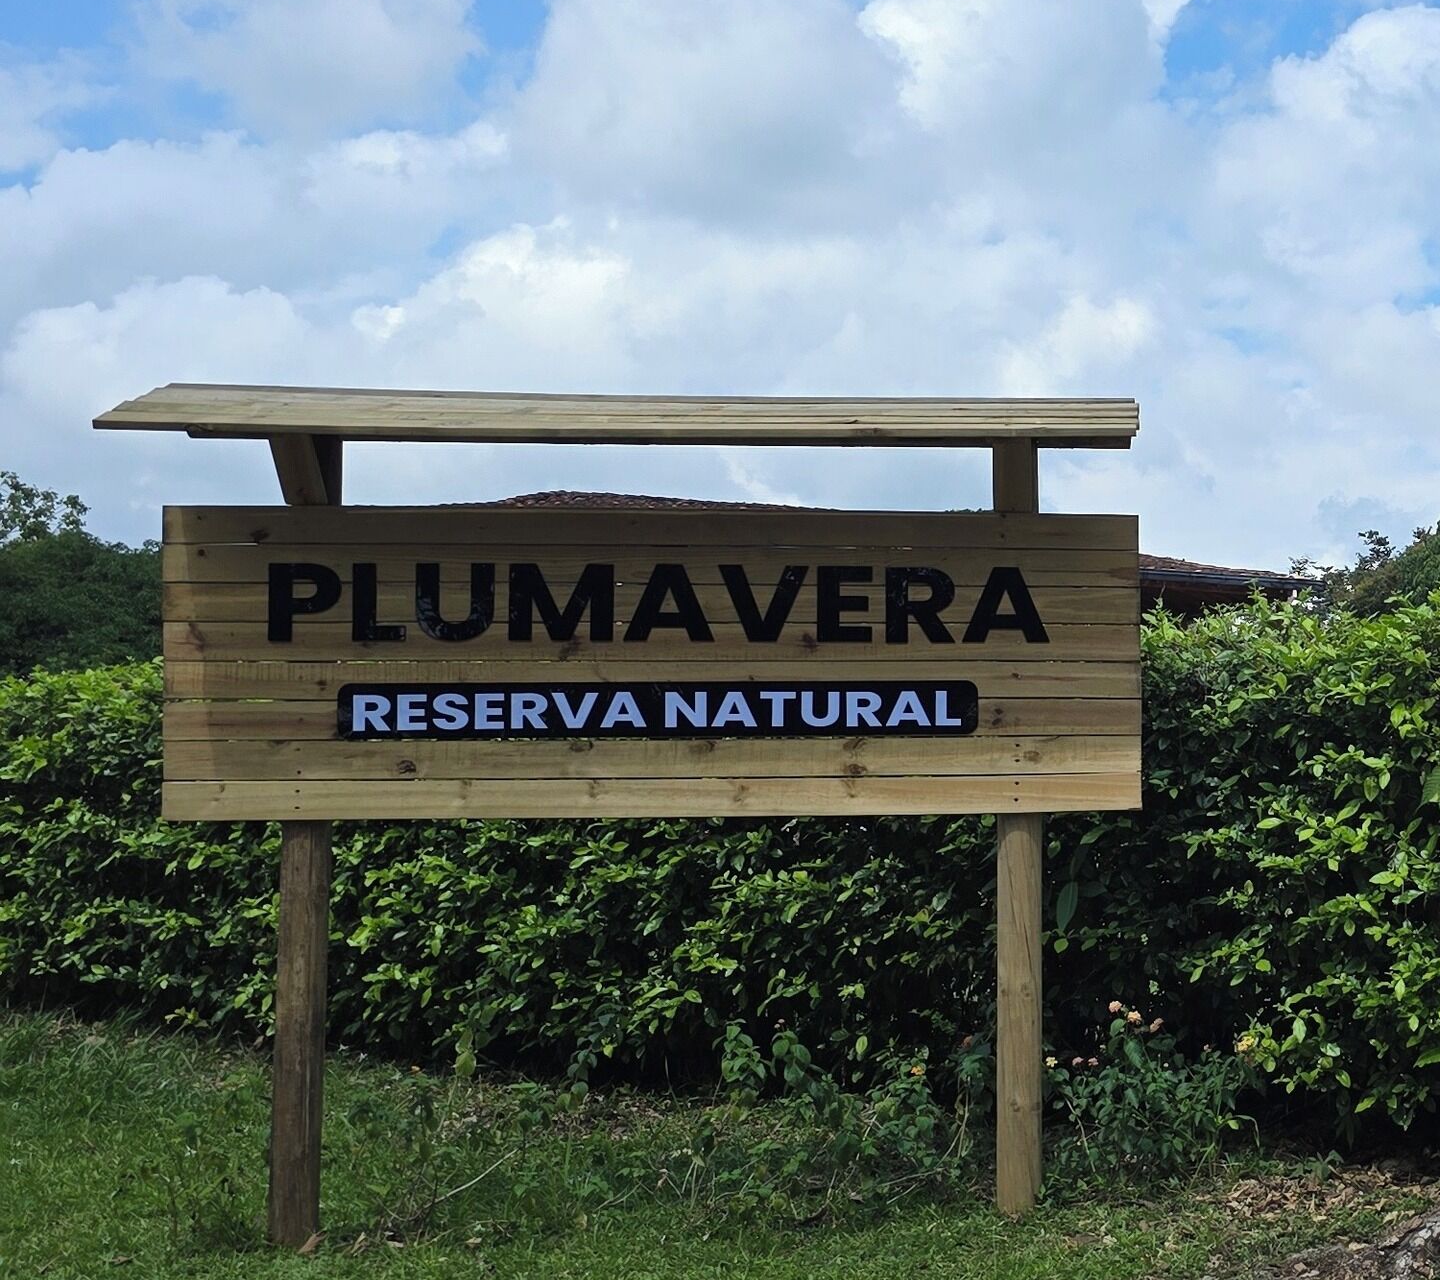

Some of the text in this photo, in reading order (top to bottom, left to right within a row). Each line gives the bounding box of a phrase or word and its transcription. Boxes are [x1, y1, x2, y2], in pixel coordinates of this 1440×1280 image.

[267, 562, 1050, 645] PLUMAVERA
[351, 690, 963, 733] RESERVA NATURAL
